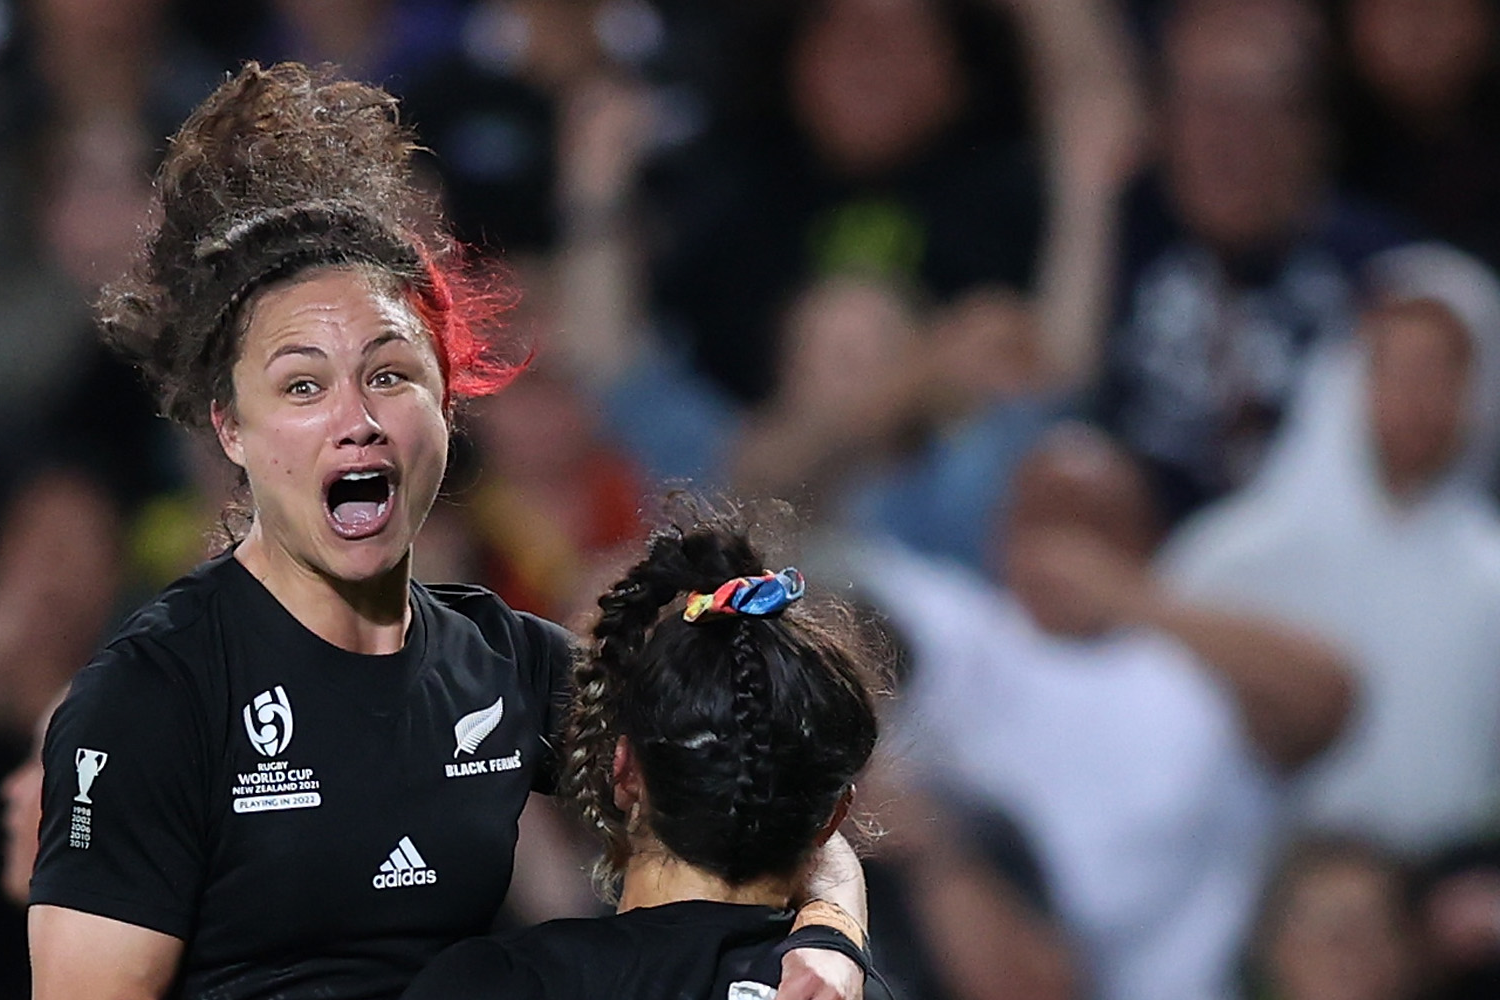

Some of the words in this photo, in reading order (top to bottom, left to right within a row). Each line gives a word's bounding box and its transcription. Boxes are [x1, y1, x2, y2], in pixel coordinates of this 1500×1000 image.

[257, 761, 289, 772] RUGBY
[444, 761, 488, 777] BLACK
[490, 755, 522, 772] FERNS
[237, 771, 286, 785] WORLD
[287, 768, 314, 782] CUP
[232, 786, 254, 795] NEW
[255, 782, 298, 794] ZEALAND
[298, 780, 320, 790] 2021
[239, 798, 279, 809] PLAYING
[280, 798, 290, 806] IN
[293, 795, 315, 805] 2022
[73, 806, 91, 816] 1998
[71, 814, 91, 825] 2002
[71, 822, 91, 834] 2006
[70, 831, 91, 841] 2010
[69, 839, 90, 849] 2017
[372, 867, 437, 889] adidas
